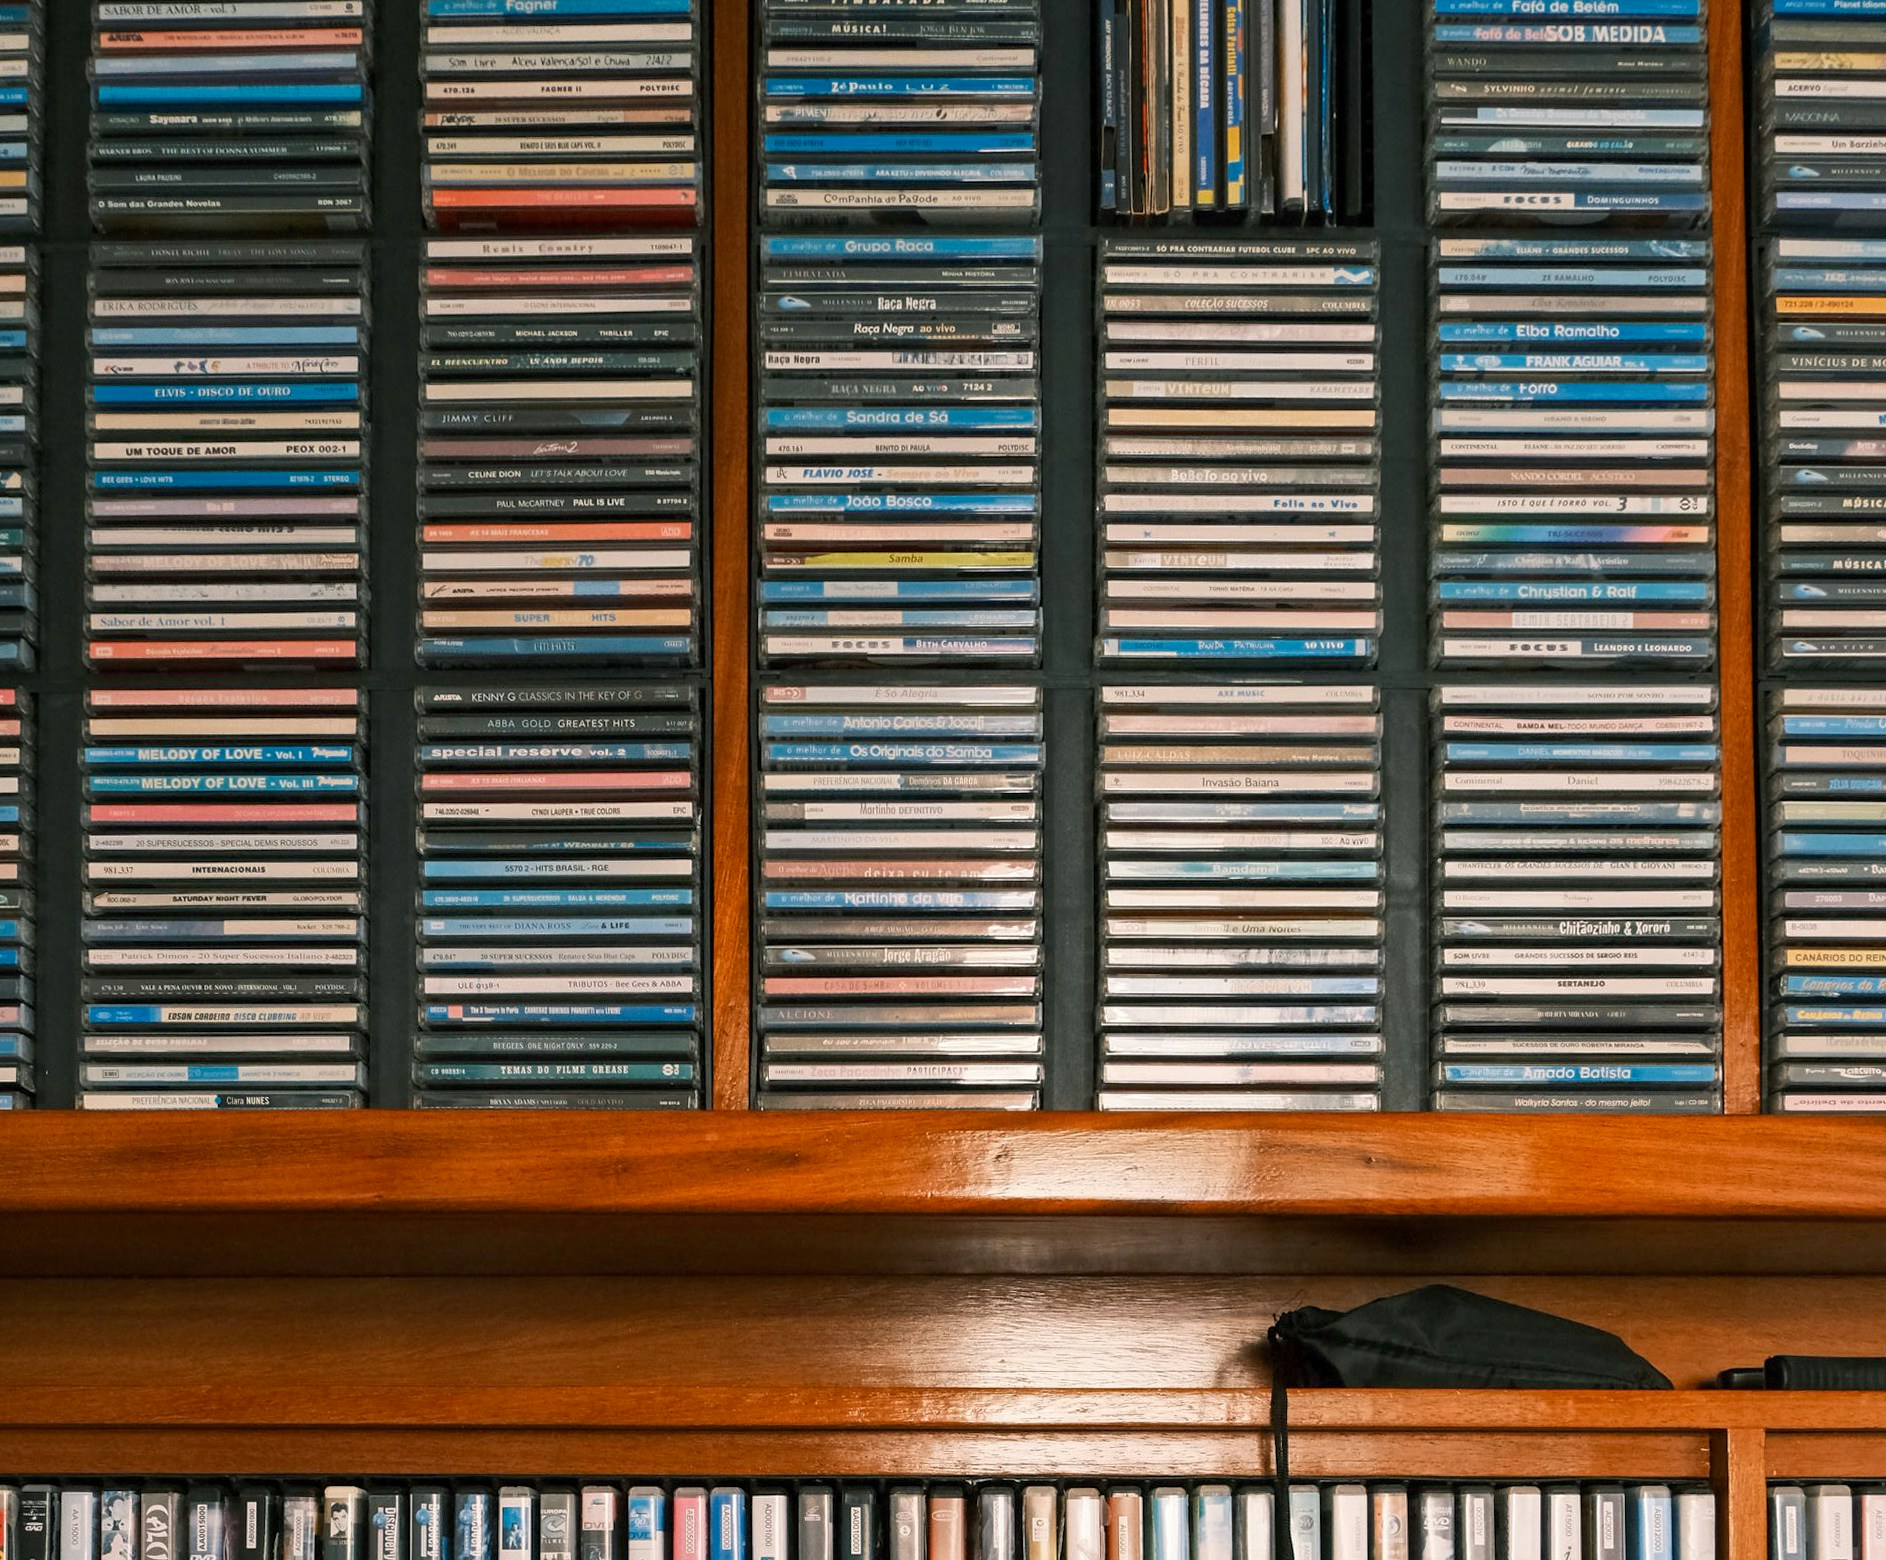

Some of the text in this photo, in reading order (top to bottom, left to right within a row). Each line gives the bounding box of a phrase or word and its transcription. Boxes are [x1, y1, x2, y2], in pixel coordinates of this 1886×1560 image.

[1546, 26, 1666, 42] SOB MEDIDA
[1587, 195, 1659, 204] DOMINGUINHOS
[1157, 244, 1167, 252] SÓ
[1187, 245, 1235, 253] CONTRARIAR
[1239, 246, 1272, 254] FUTEBOL
[1275, 246, 1296, 254] CLUBE
[1516, 325, 1620, 337] Elba Ramalho
[1526, 356, 1621, 368] FRANK AGUIAR
[1791, 356, 1868, 367] VINÍCIUS DE
[155, 387, 291, 397] ELVIS DISCO DE OURO
[126, 445, 346, 456] UM TOQUE DE AMOR PEOX 002-1
[846, 496, 932, 508] João Bosco
[1518, 586, 1637, 599] Chrystian & Ralf
[472, 690, 642, 702] KENNY G CLASSICS IN THE KEY OF G
[431, 747, 626, 758] special reserve vol. 2
[141, 777, 313, 789] MELODY OF LOVE Vol. III
[1202, 777, 1280, 789] Invasão Baiana
[1795, 951, 1862, 962] CANÁRIOS DO
[1558, 980, 1605, 988] SERTANEJO
[1523, 1067, 1631, 1079] Amado Batista
